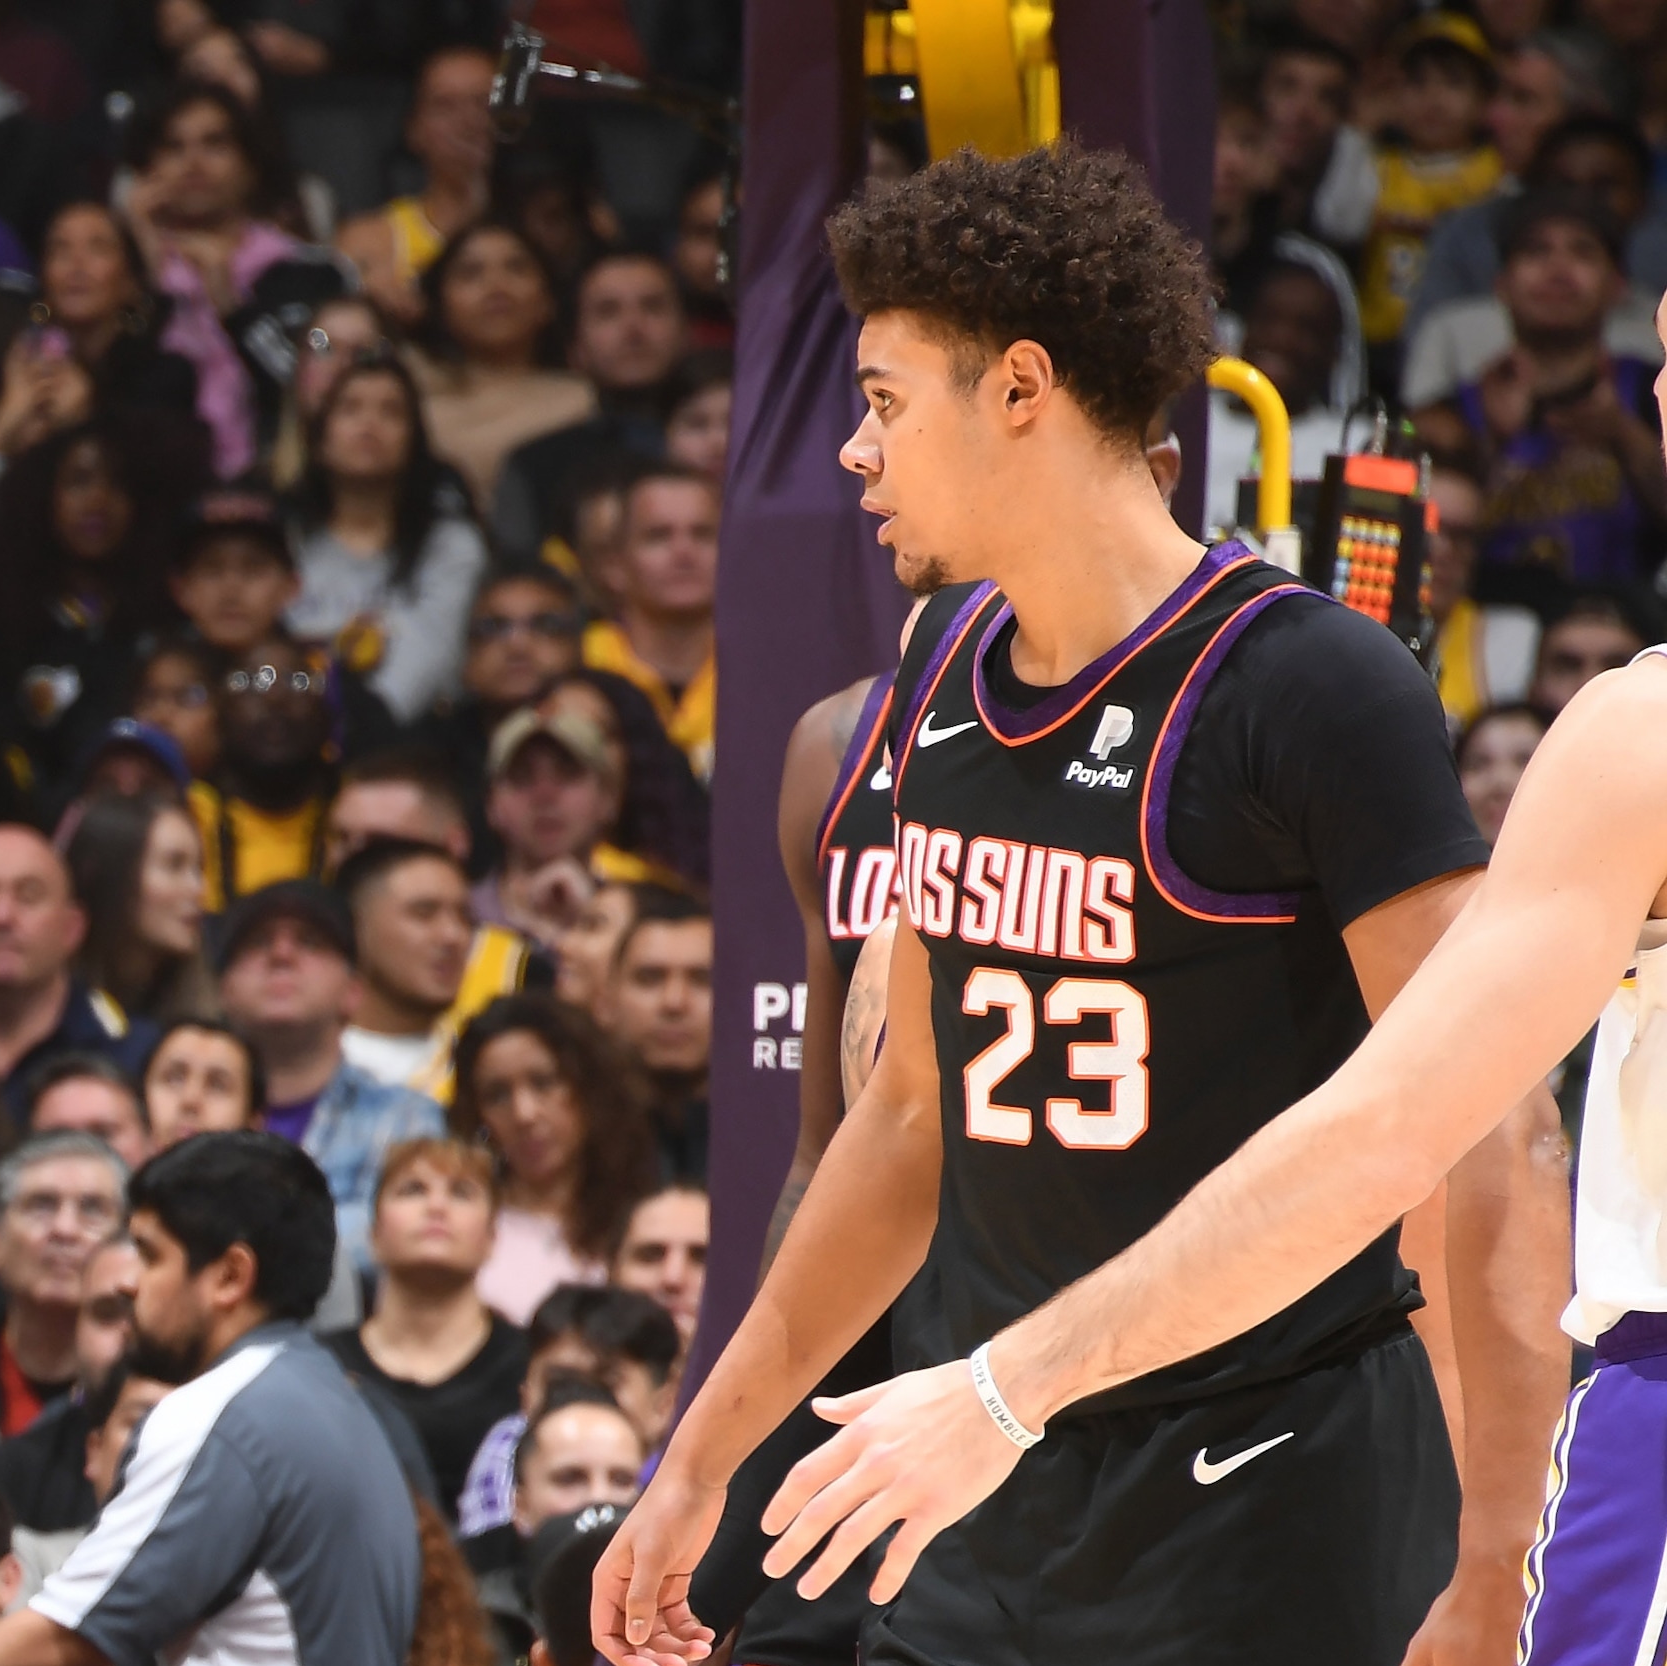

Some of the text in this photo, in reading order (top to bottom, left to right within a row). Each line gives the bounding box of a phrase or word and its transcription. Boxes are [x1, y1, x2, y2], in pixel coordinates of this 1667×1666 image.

[1066, 761, 1134, 788] PayPal
[958, 835, 1136, 964] SUNS
[962, 966, 1151, 1150] 23
[986, 1396, 1026, 1442] HUMBLE
